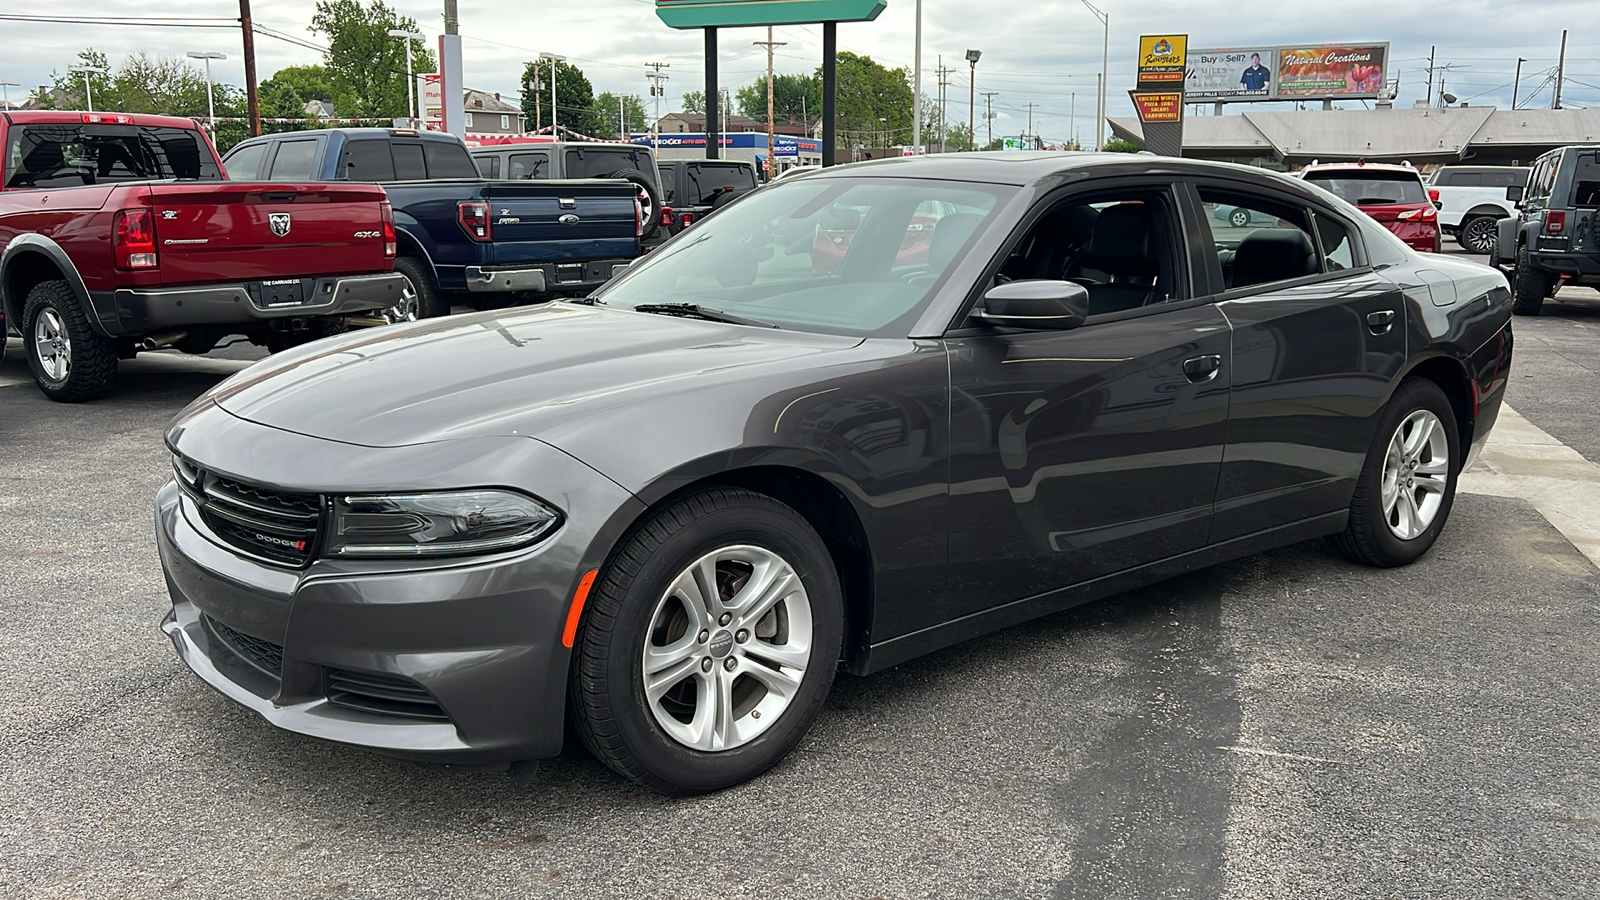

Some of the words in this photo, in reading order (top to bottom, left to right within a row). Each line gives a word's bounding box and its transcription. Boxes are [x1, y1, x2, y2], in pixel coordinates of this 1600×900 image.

[1144, 54, 1181, 65] Roosters
[1201, 56, 1217, 64] Buy
[1226, 54, 1246, 62] Sell?
[1285, 54, 1324, 66] Natural
[1325, 52, 1371, 65] Creations
[256, 533, 300, 548] DODGE
